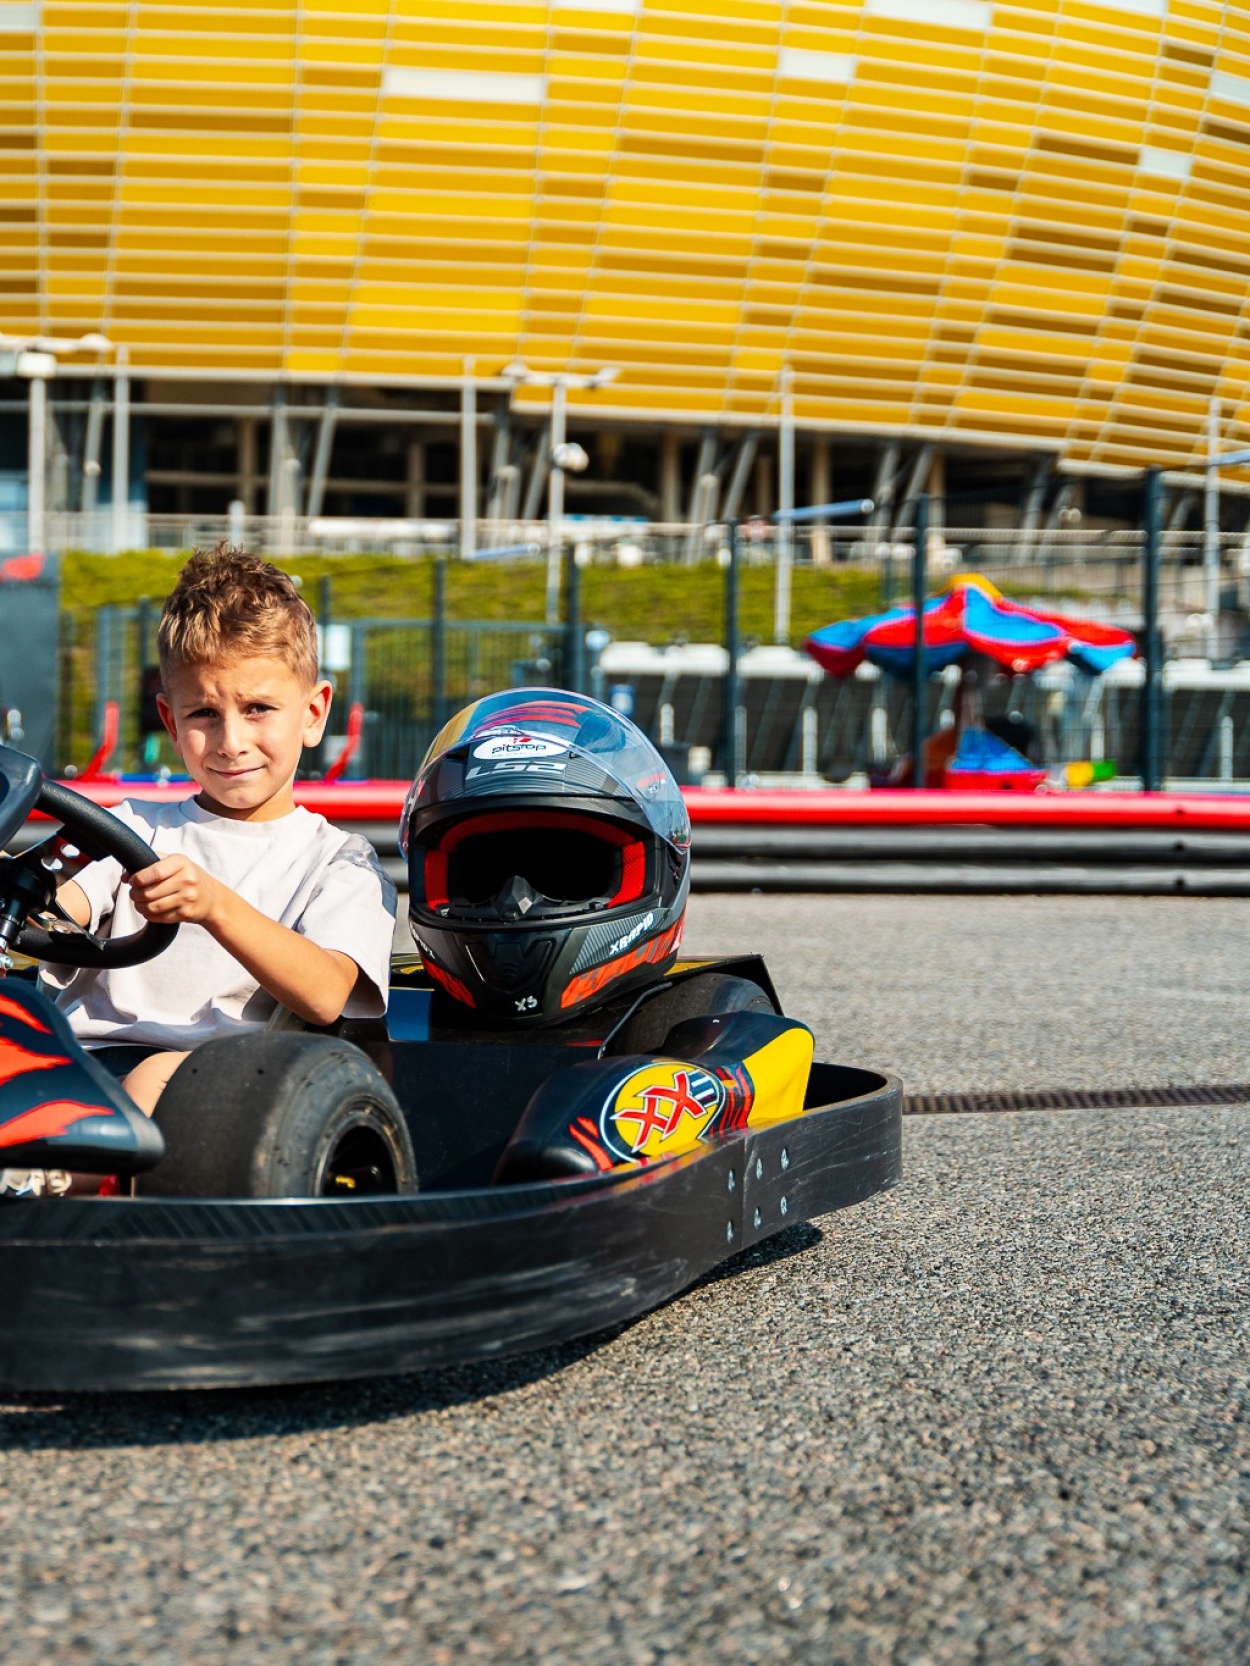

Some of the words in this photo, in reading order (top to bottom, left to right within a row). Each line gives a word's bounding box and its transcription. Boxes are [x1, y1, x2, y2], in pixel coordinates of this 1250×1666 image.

[492, 743, 547, 754] pitstop
[465, 760, 567, 780] LS2
[514, 995, 538, 1012] XS
